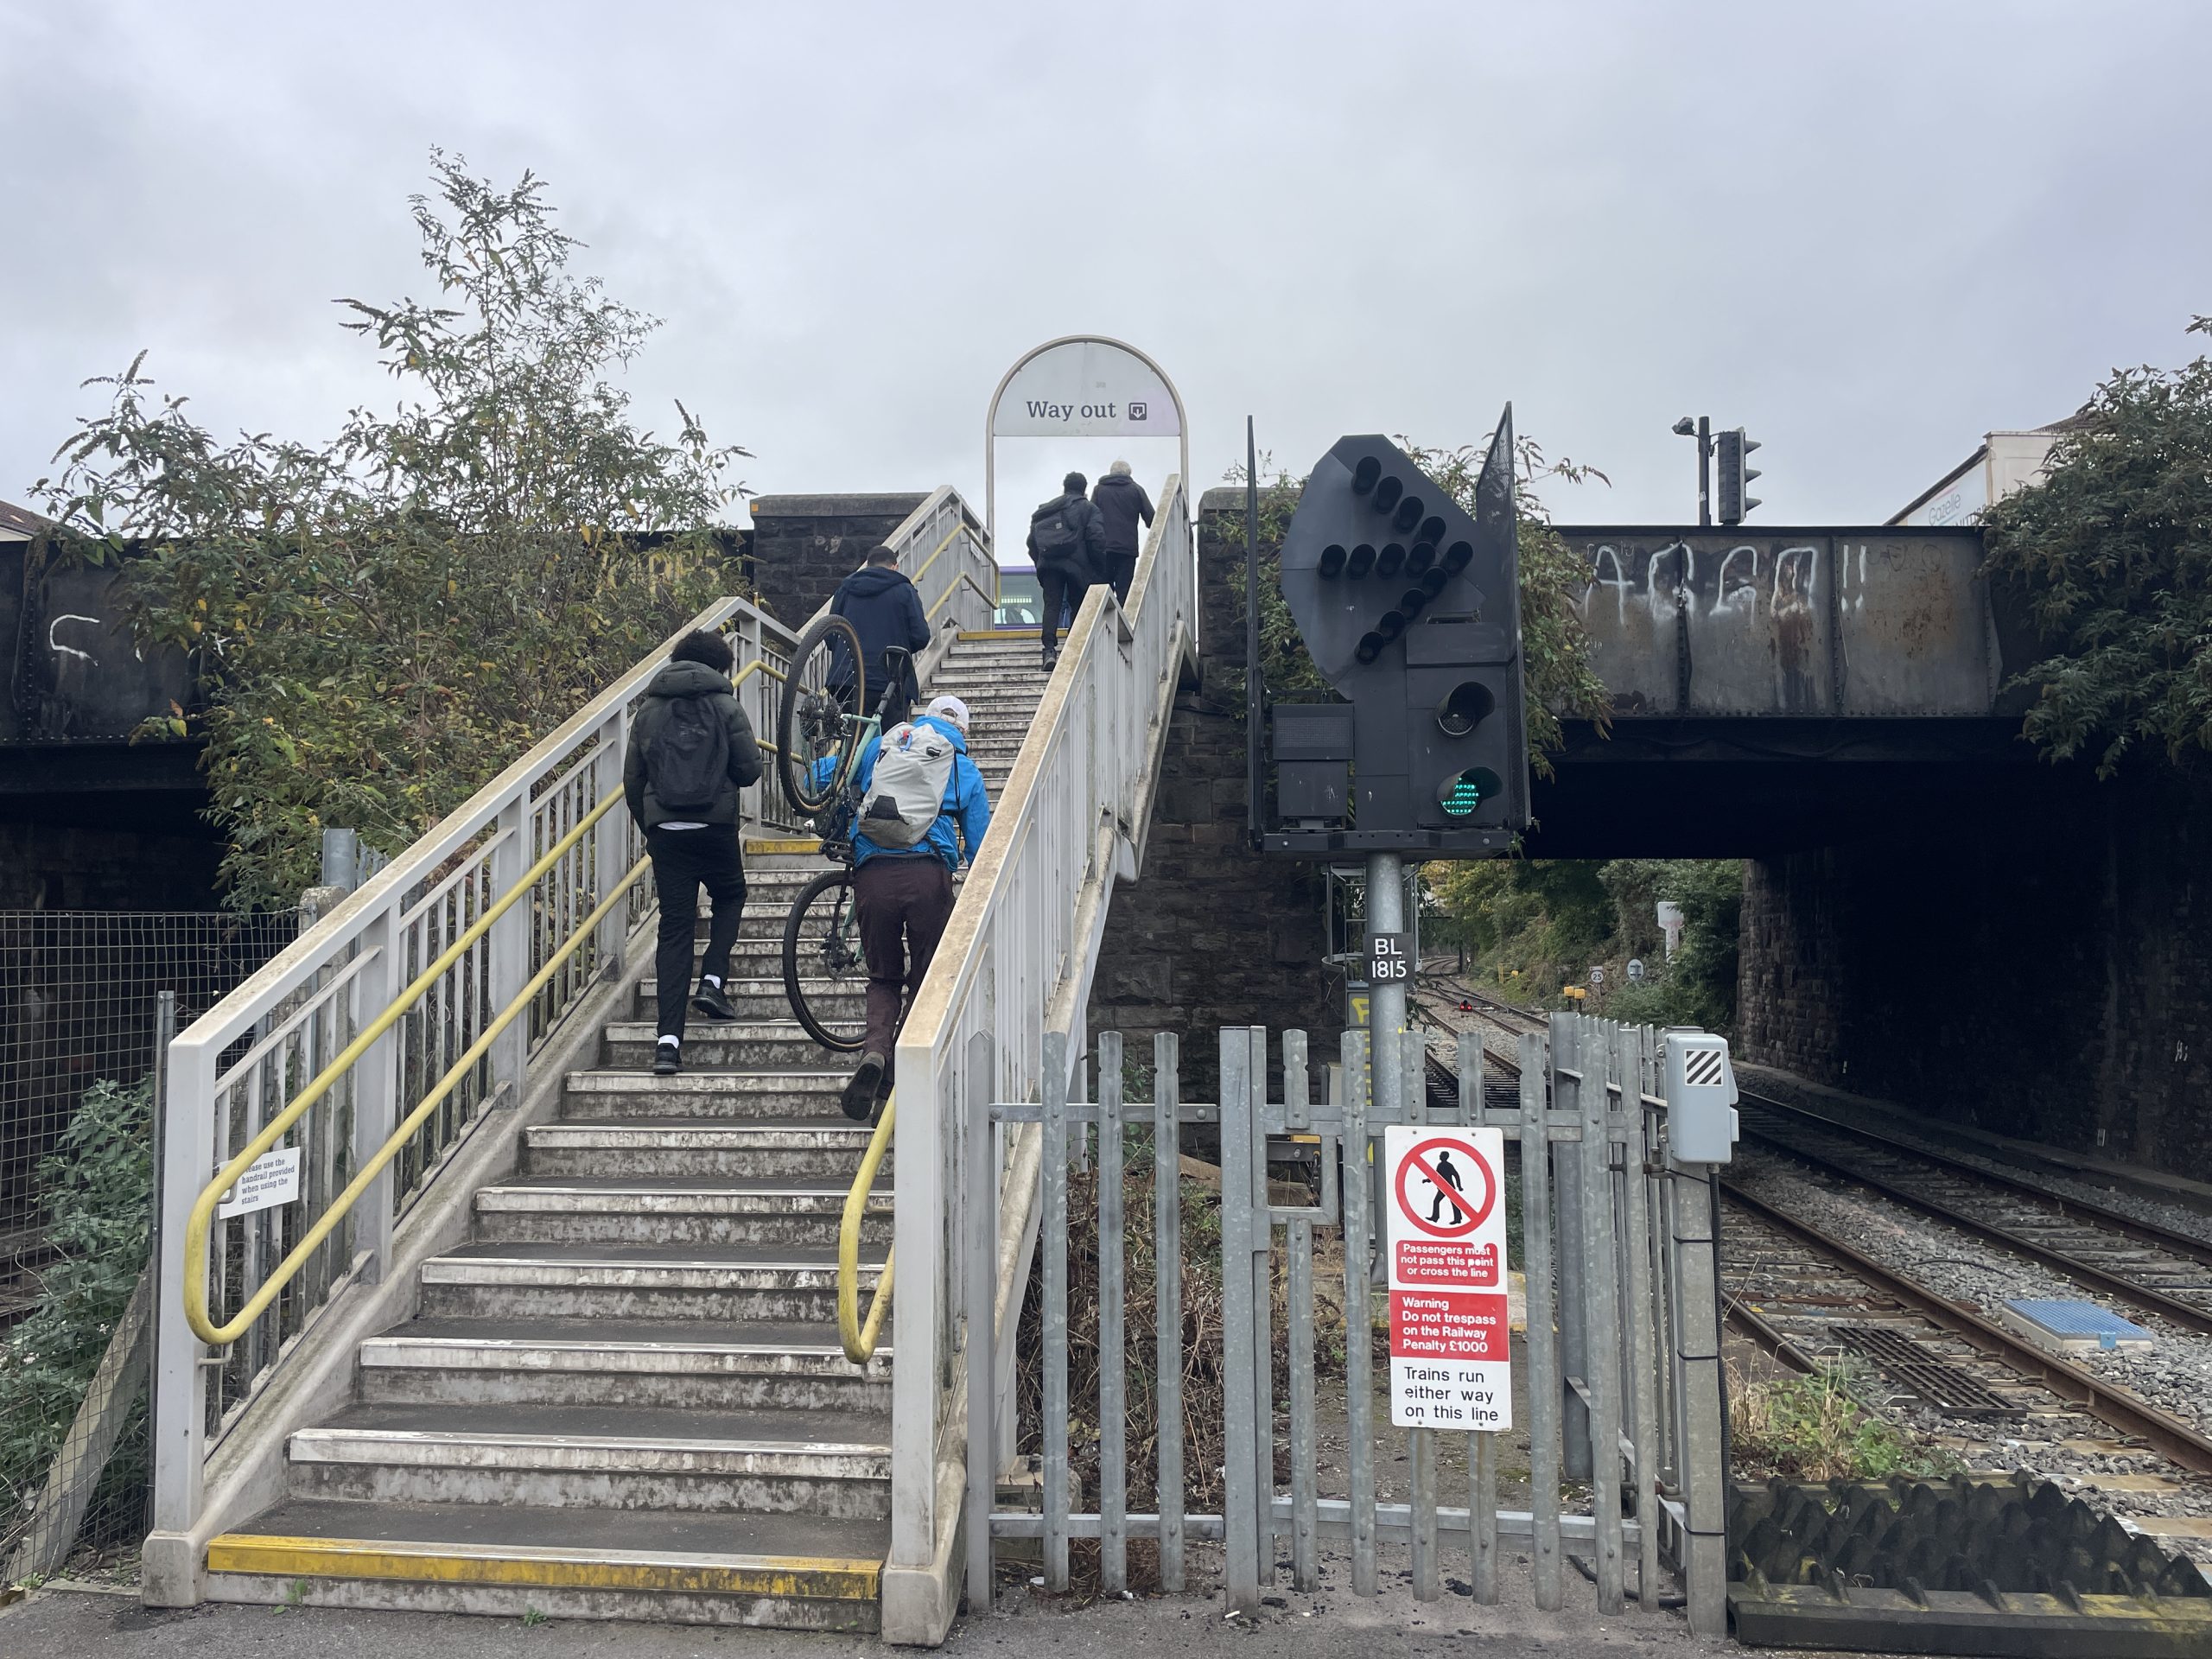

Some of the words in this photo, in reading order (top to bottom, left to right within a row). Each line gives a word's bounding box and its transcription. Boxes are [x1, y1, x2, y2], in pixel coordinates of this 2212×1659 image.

[1026, 400, 1074, 422] Way
[1080, 402, 1116, 418] out
[1929, 493, 1961, 526] Gazelle
[1375, 938, 1402, 956] BL
[1371, 960, 1407, 978] 1815
[275, 1158, 285, 1166] the
[241, 1172, 268, 1185] handrail
[269, 1165, 296, 1180] provided
[241, 1184, 259, 1194] when
[260, 1179, 276, 1191] using
[277, 1177, 289, 1185] the
[241, 1195, 259, 1205] stairs
[1403, 1243, 1463, 1255] Passengers
[1465, 1246, 1491, 1255] must
[1401, 1255, 1418, 1264] not
[1419, 1257, 1445, 1266] pass
[1446, 1256, 1465, 1266] this
[1467, 1257, 1494, 1268] point
[1420, 1268, 1449, 1276] cross
[1452, 1268, 1468, 1277] the
[1470, 1268, 1488, 1278] line
[1402, 1296, 1449, 1311] Warning
[1402, 1310, 1420, 1322] Do
[1421, 1313, 1441, 1323] not
[1444, 1313, 1497, 1325] trespass
[1402, 1326, 1418, 1336] on
[1421, 1325, 1440, 1337] the
[1442, 1325, 1487, 1340] Railway
[1402, 1338, 1446, 1353] Penalty
[1449, 1340, 1489, 1353] £1000
[1404, 1366, 1450, 1381] Trains
[1459, 1371, 1484, 1383] run
[1405, 1385, 1451, 1400] either
[1460, 1390, 1494, 1405] way
[1405, 1406, 1425, 1417] on
[1433, 1404, 1463, 1420] this
[1471, 1407, 1499, 1421] line
